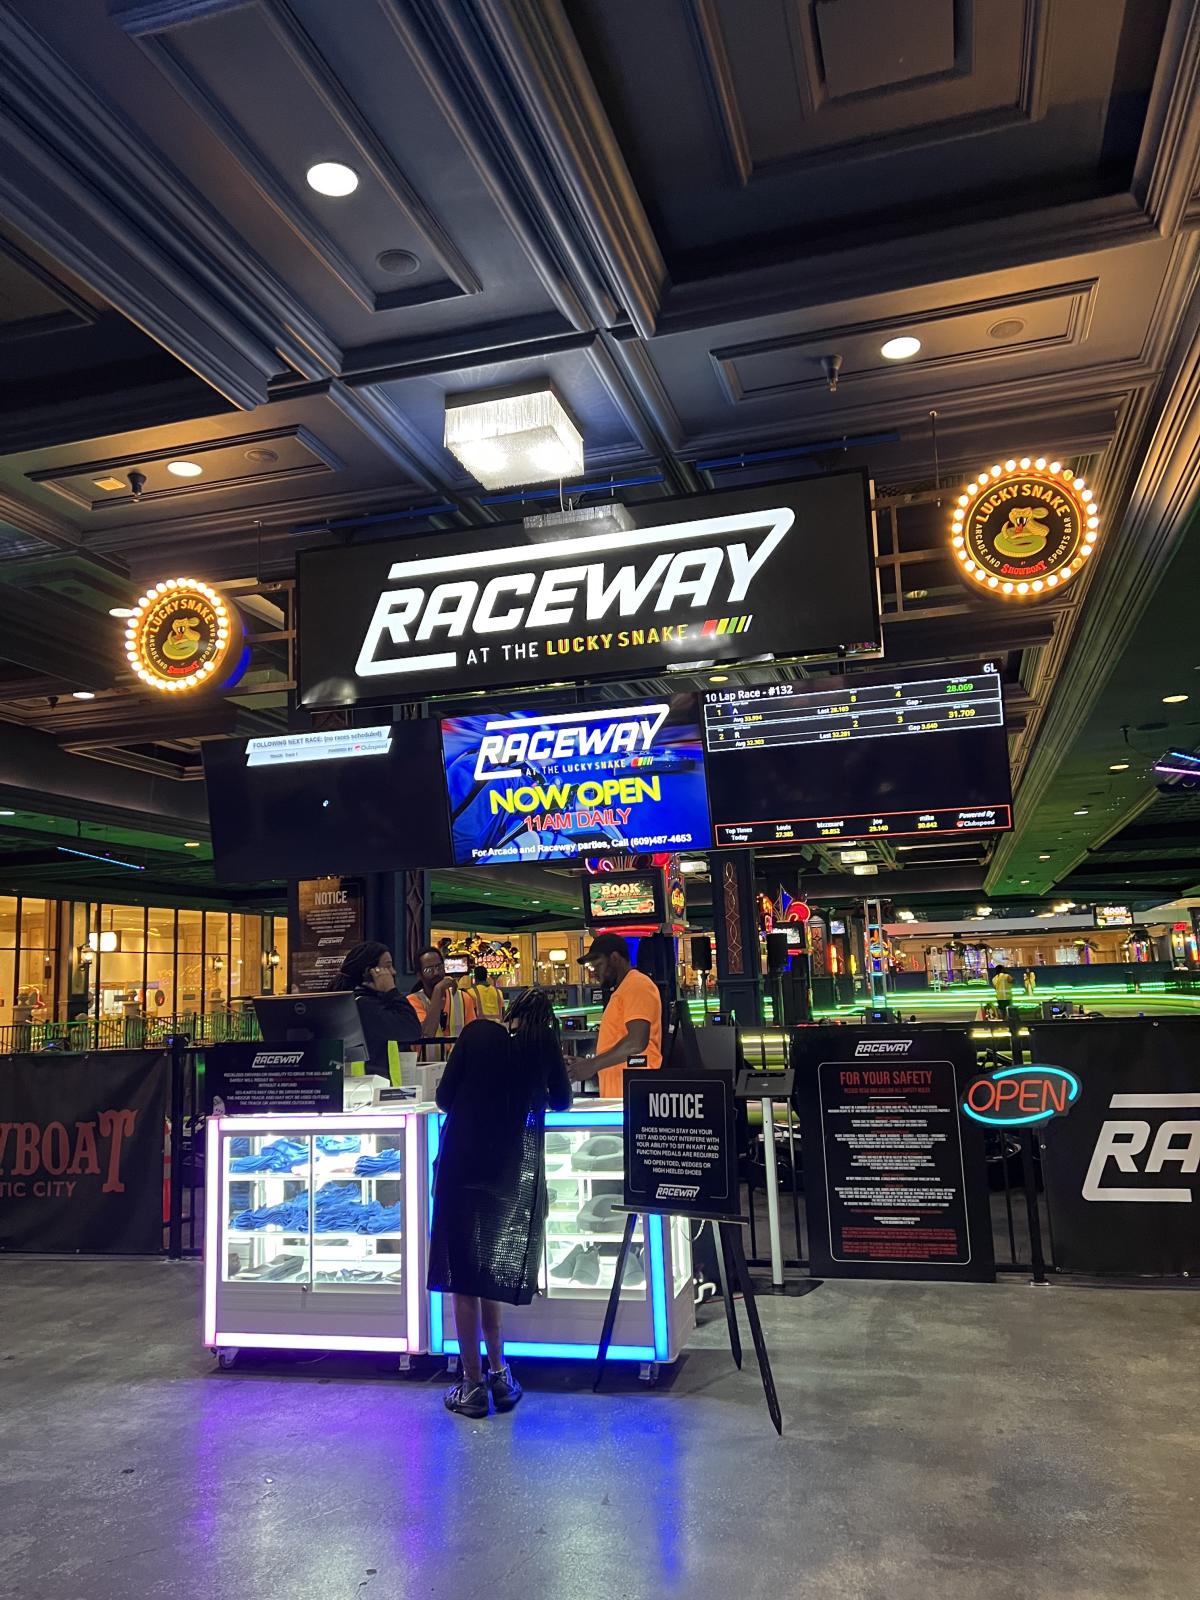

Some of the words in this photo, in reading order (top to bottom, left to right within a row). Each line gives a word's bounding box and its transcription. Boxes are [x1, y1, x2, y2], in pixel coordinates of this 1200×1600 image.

[976, 485, 1018, 523] LUCKY
[1021, 484, 1070, 516] SNAKE
[975, 524, 988, 554] ARCADE
[985, 554, 1000, 568] AND
[1048, 536, 1070, 564] SPORTS
[1064, 517, 1072, 534] BAR
[366, 536, 776, 649] RACEWAY
[150, 600, 179, 632] LUCKY
[180, 599, 215, 624] SNAKE
[467, 648, 488, 664] AT
[502, 642, 539, 660] THE
[546, 633, 612, 656] LUCKY
[617, 624, 690, 647] SNAKE
[983, 663, 997, 673] 6L
[706, 693, 716, 702] 10
[719, 692, 735, 702] Lap
[738, 689, 760, 699] Race
[768, 685, 793, 696] #132
[253, 739, 287, 748] FOLLOWING
[476, 714, 662, 768] RACEWAY
[542, 764, 559, 774] THE
[562, 762, 593, 772] LUCKY
[595, 759, 626, 770] SNAKE
[489, 783, 571, 814] NOW
[576, 775, 661, 806] OPEN
[523, 812, 572, 832] 11AM
[577, 808, 632, 828] DAILY
[472, 848, 487, 858] For
[488, 847, 519, 856] Arcade
[520, 845, 536, 854] and
[537, 842, 576, 854] Raceway
[612, 837, 628, 847] Call
[315, 890, 348, 905] NOTICE
[601, 883, 640, 895] BOOK
[856, 1042, 911, 1054] RACEWAY
[253, 1054, 302, 1066] RACEWAY
[840, 1072, 859, 1085] FOR
[862, 1071, 890, 1085] YOUR
[893, 1070, 932, 1085] SAFETY
[649, 1093, 704, 1118] NOTICE
[968, 1080, 1067, 1112] OPEN
[33, 1181, 77, 1198] CITY
[656, 1186, 698, 1198] RACEWAY
